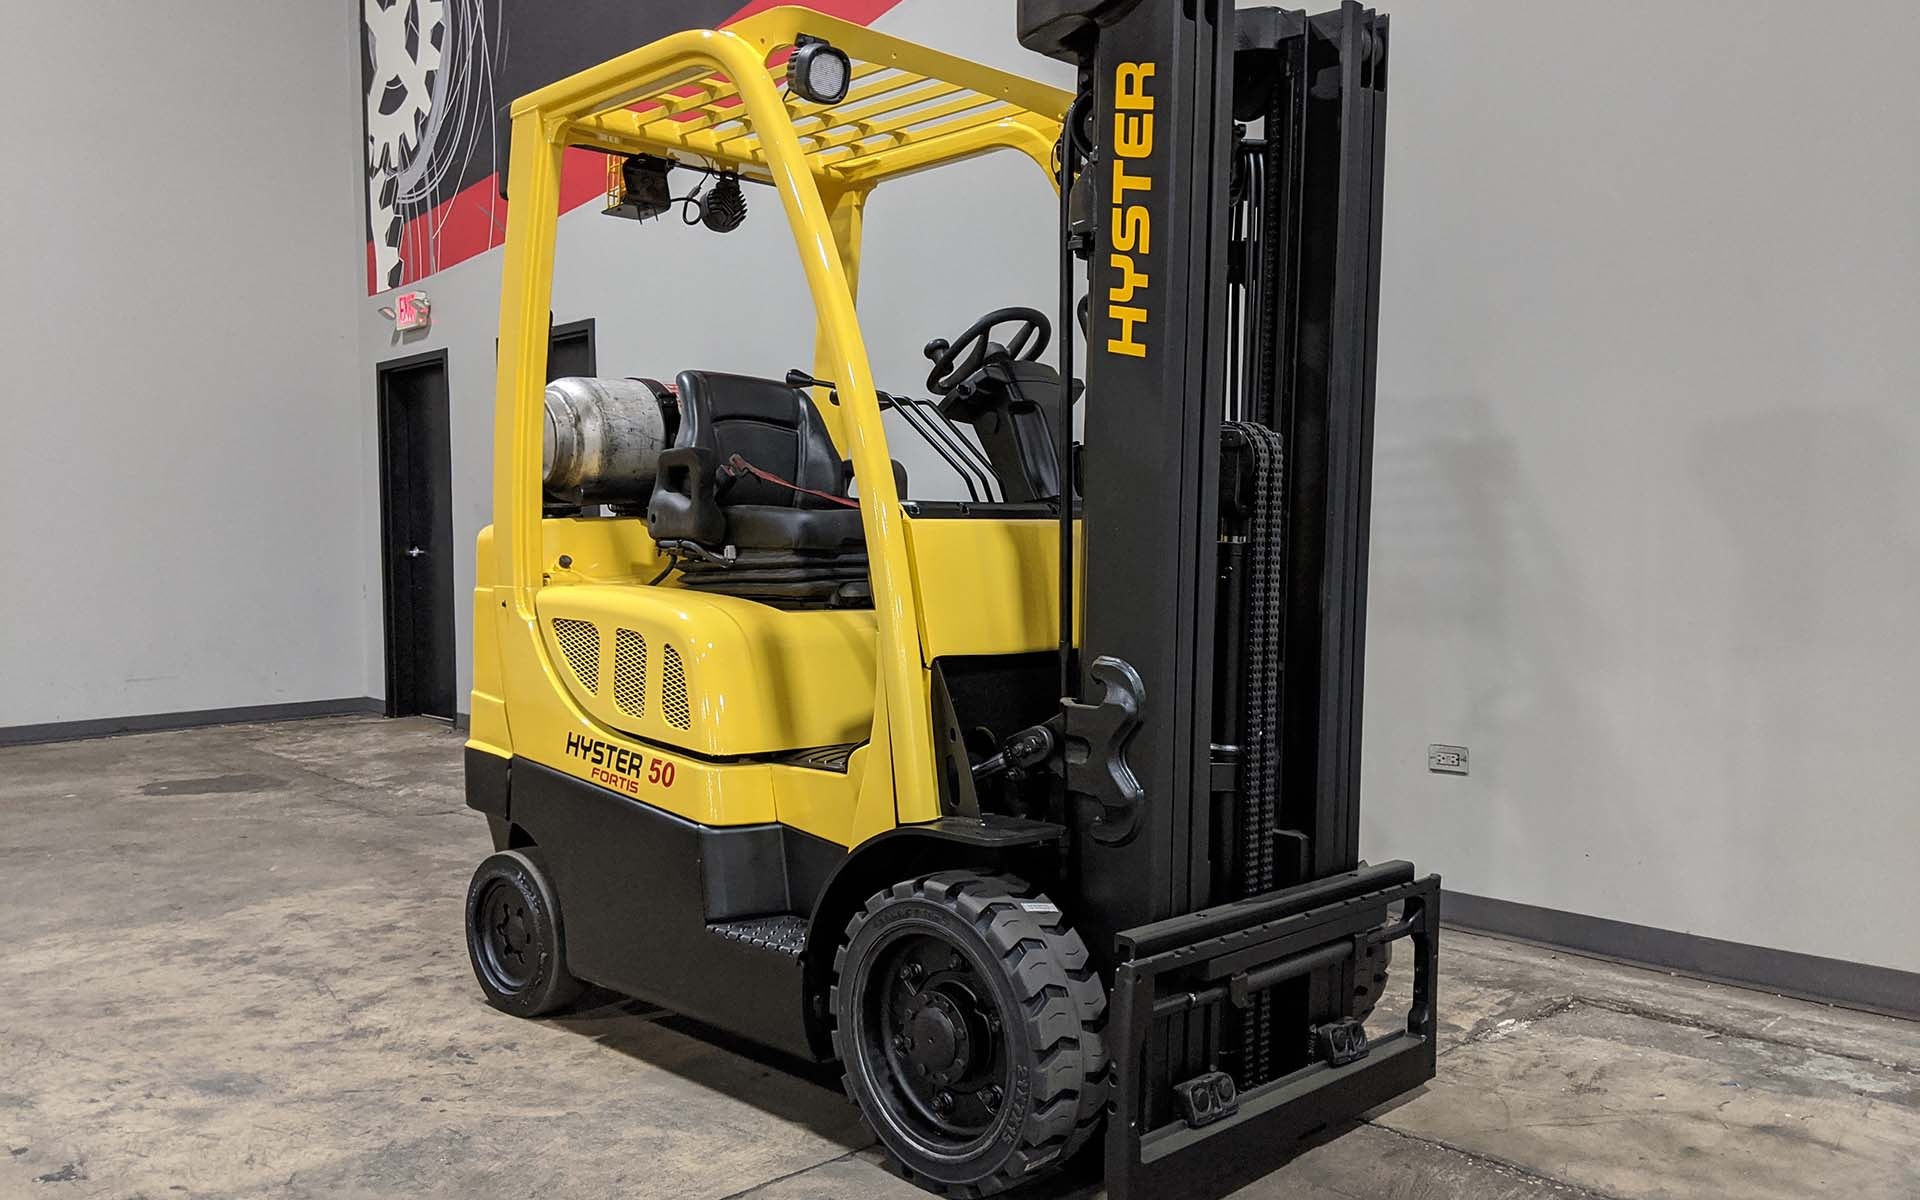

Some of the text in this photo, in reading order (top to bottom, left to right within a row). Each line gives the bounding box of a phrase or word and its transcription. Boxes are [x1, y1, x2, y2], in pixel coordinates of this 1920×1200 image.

[1107, 61, 1155, 358] HYSTER
[565, 731, 675, 788] HYSTER 50
[591, 767, 640, 794] FORTIS
